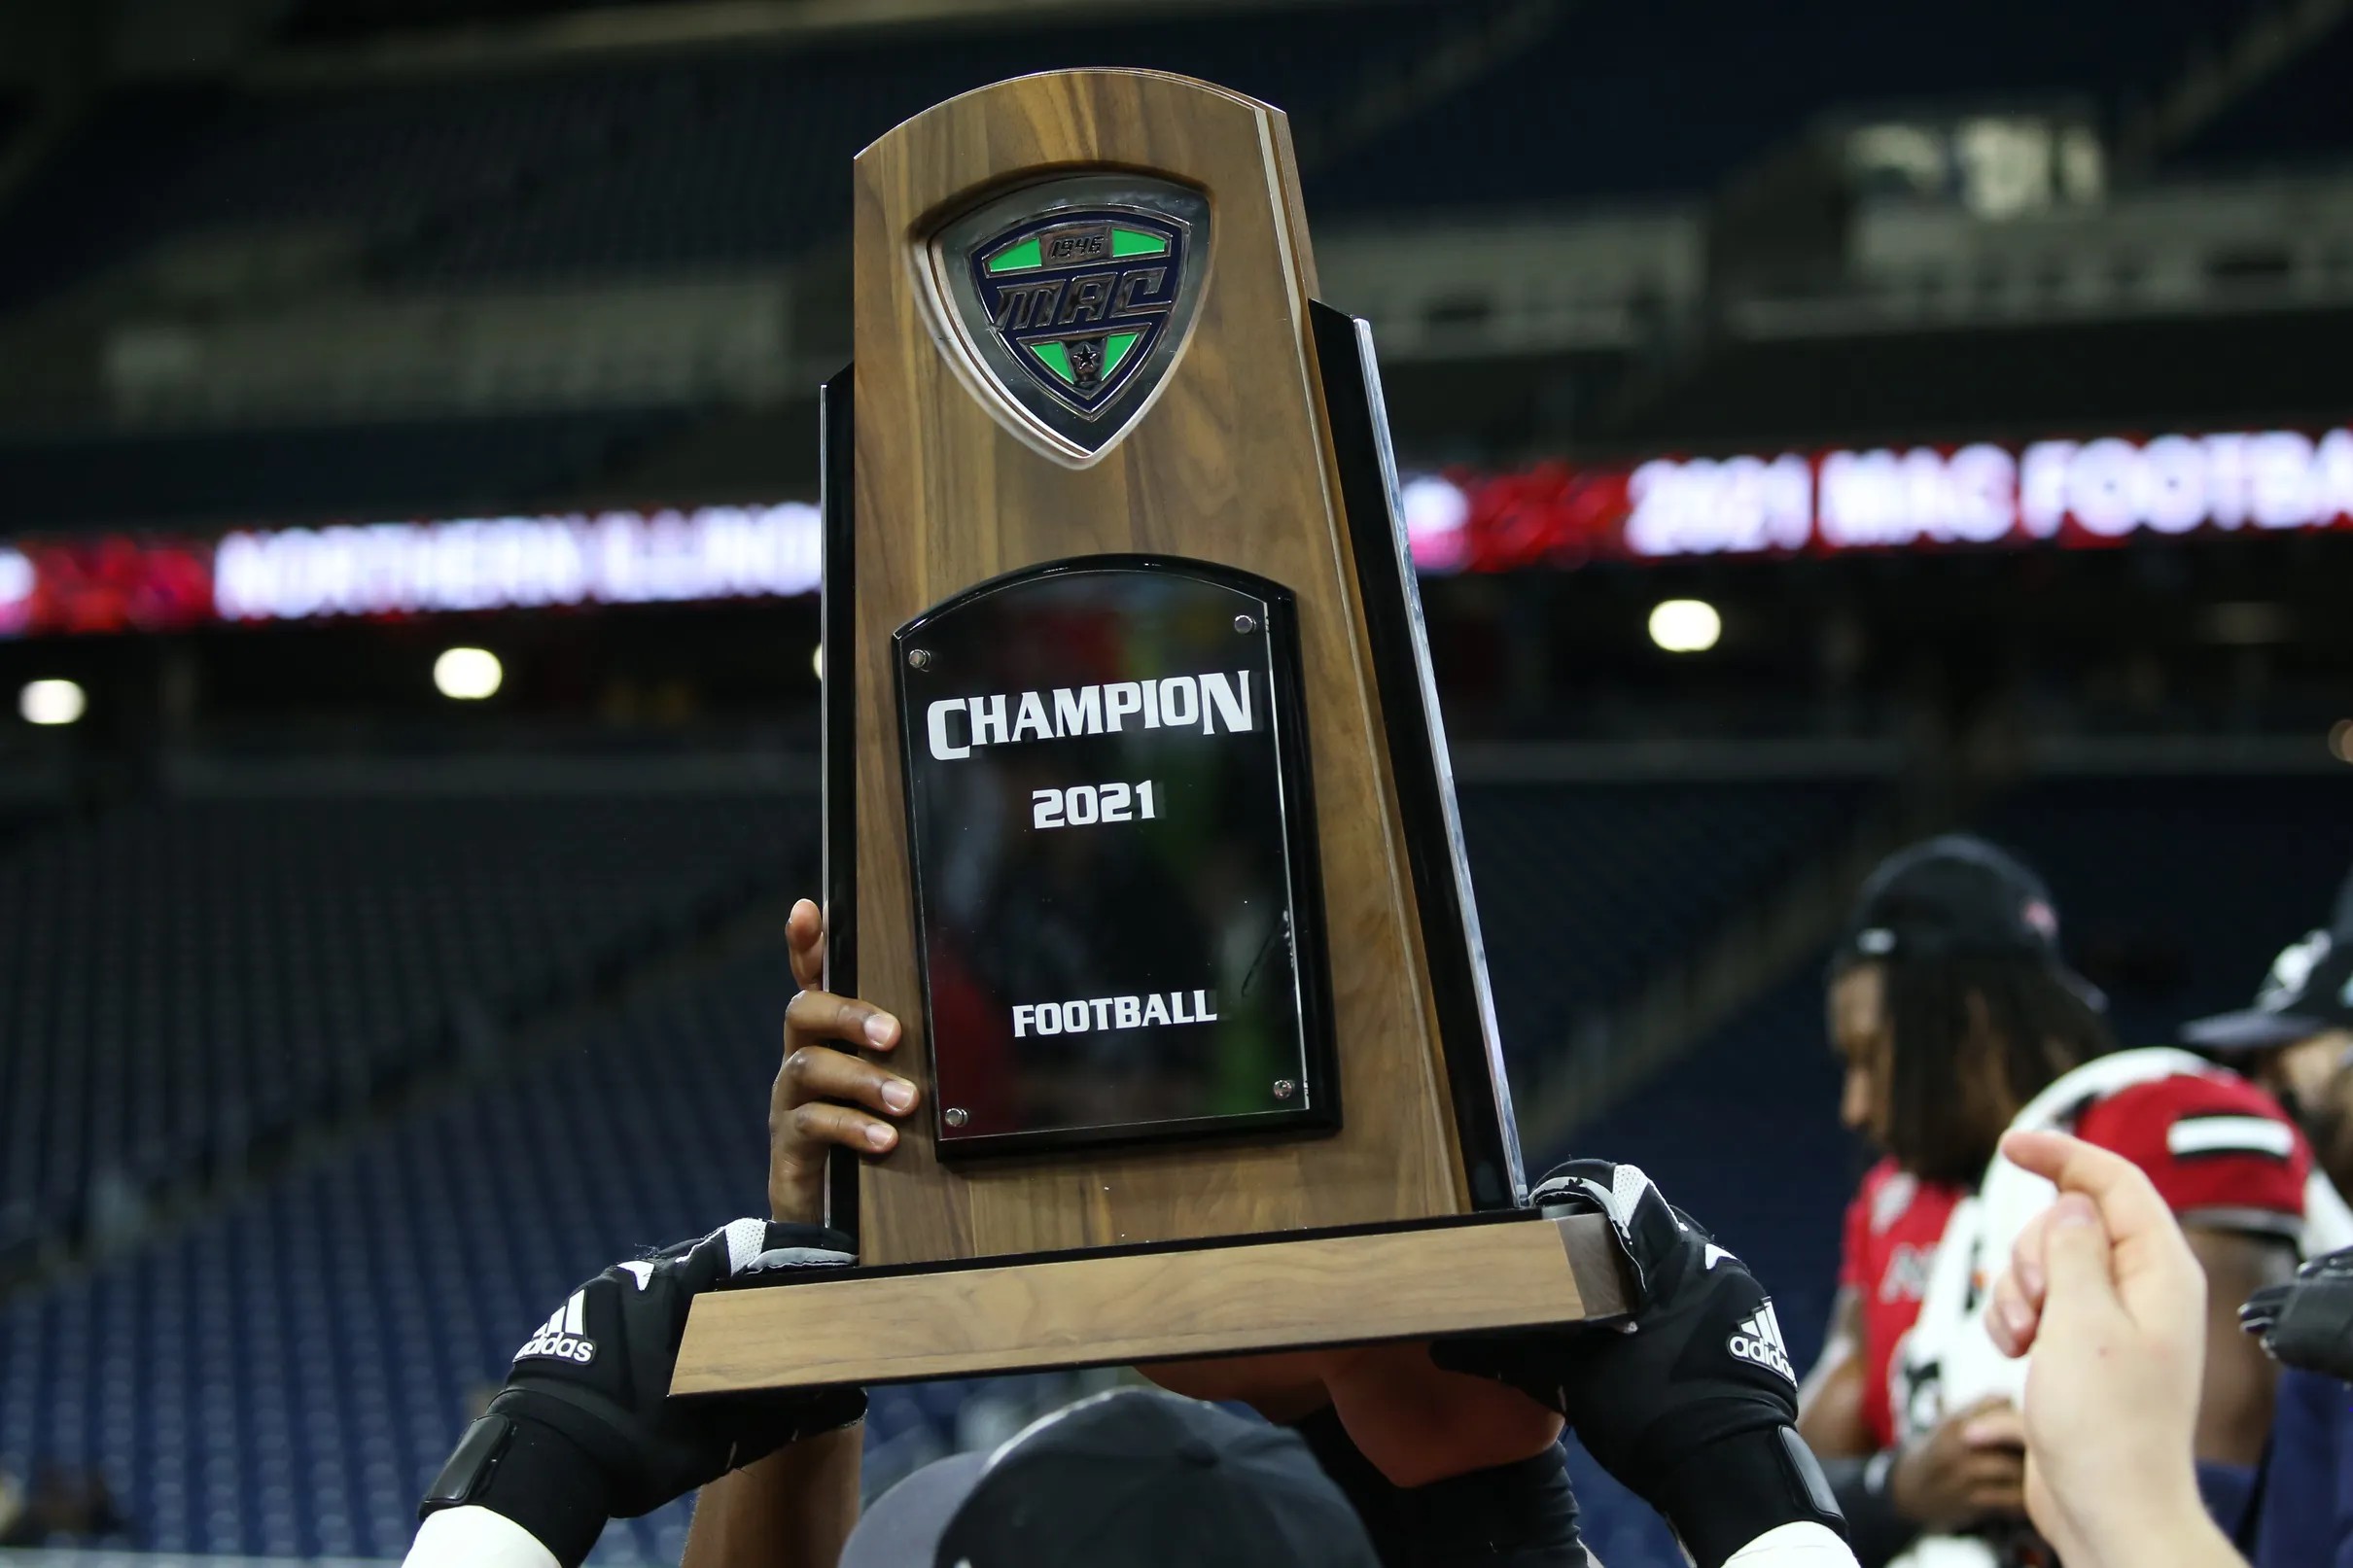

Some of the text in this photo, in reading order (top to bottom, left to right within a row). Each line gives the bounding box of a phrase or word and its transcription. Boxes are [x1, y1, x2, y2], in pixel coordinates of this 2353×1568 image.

[1051, 235, 1105, 261] 1946
[993, 266, 1173, 332] MAC
[927, 669, 1253, 761] CHAMPION
[1032, 780, 1155, 829] 2021
[1012, 989, 1218, 1038] FOOTBALL
